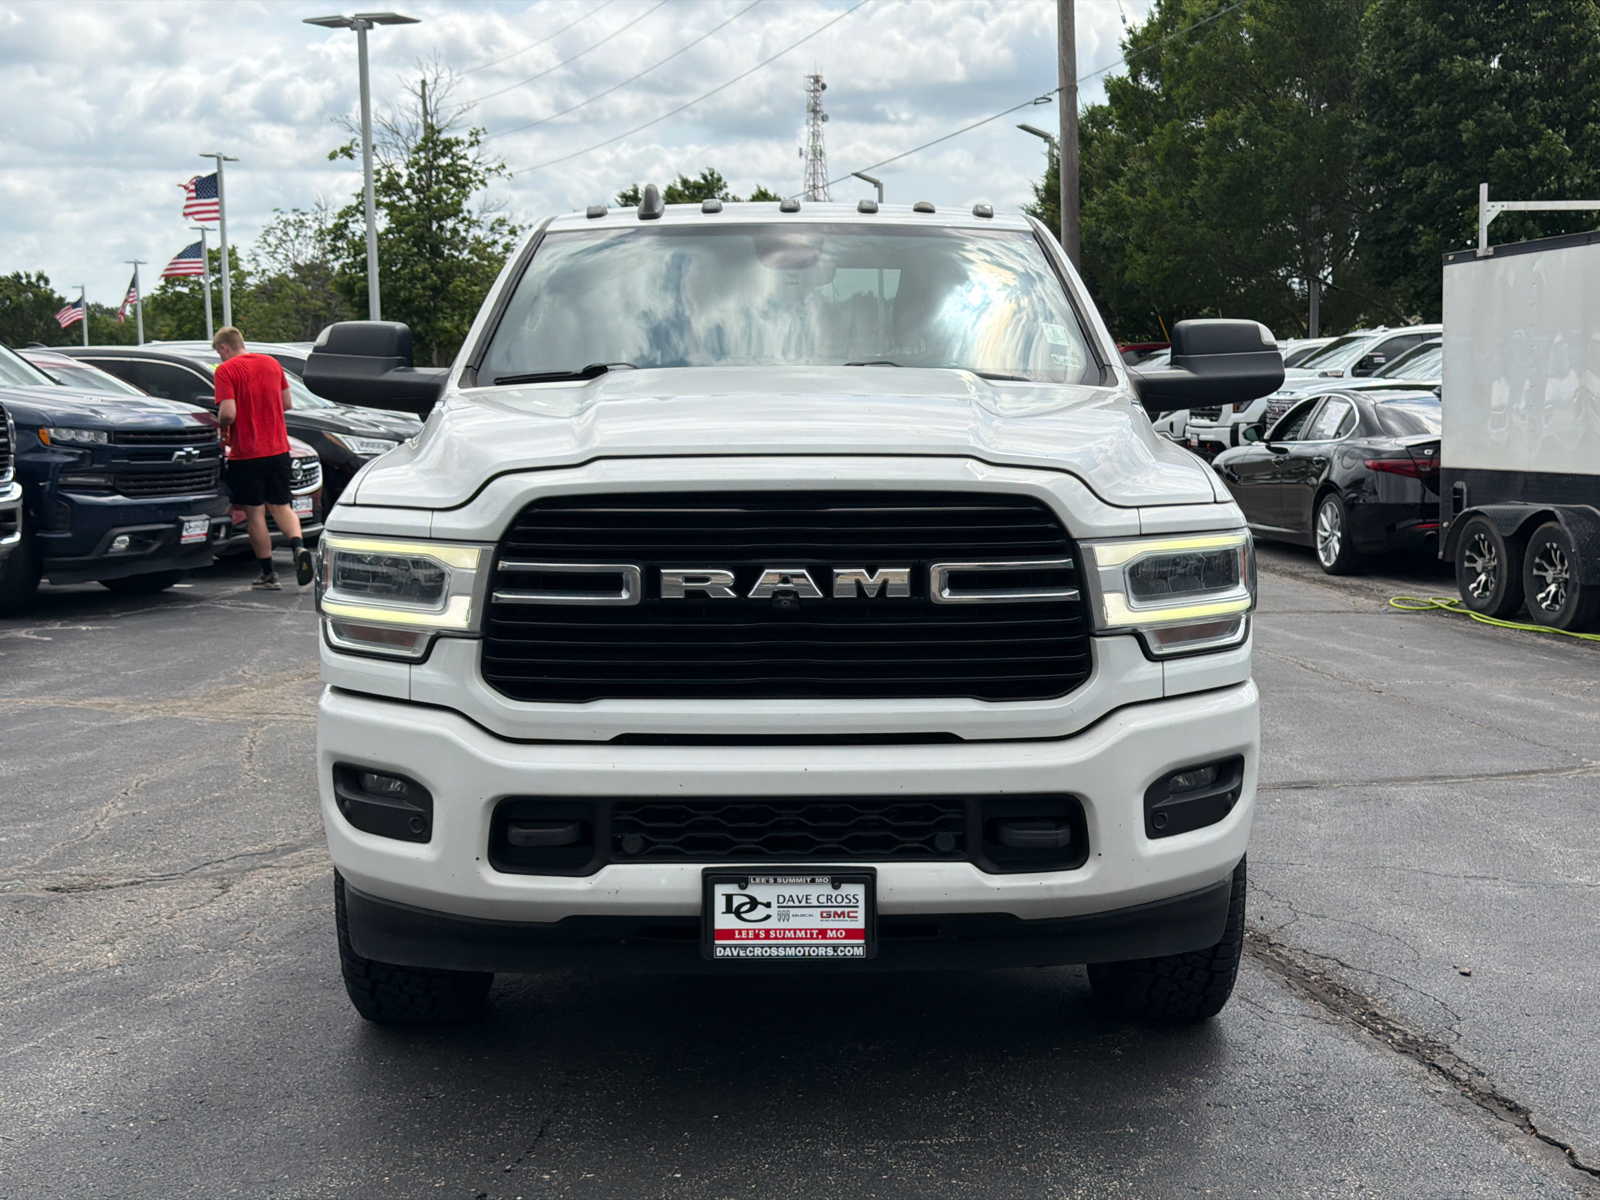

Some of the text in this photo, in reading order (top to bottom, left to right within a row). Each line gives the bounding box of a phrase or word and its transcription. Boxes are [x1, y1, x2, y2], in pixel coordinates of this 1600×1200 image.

[660, 569, 910, 598] RAM
[777, 894, 859, 904] DAVE CROSS
[820, 910, 858, 919] GMC
[734, 929, 846, 940] LEE'S SUMMIT, MO
[716, 946, 864, 957] DAVECROSSMOTORS.COM
